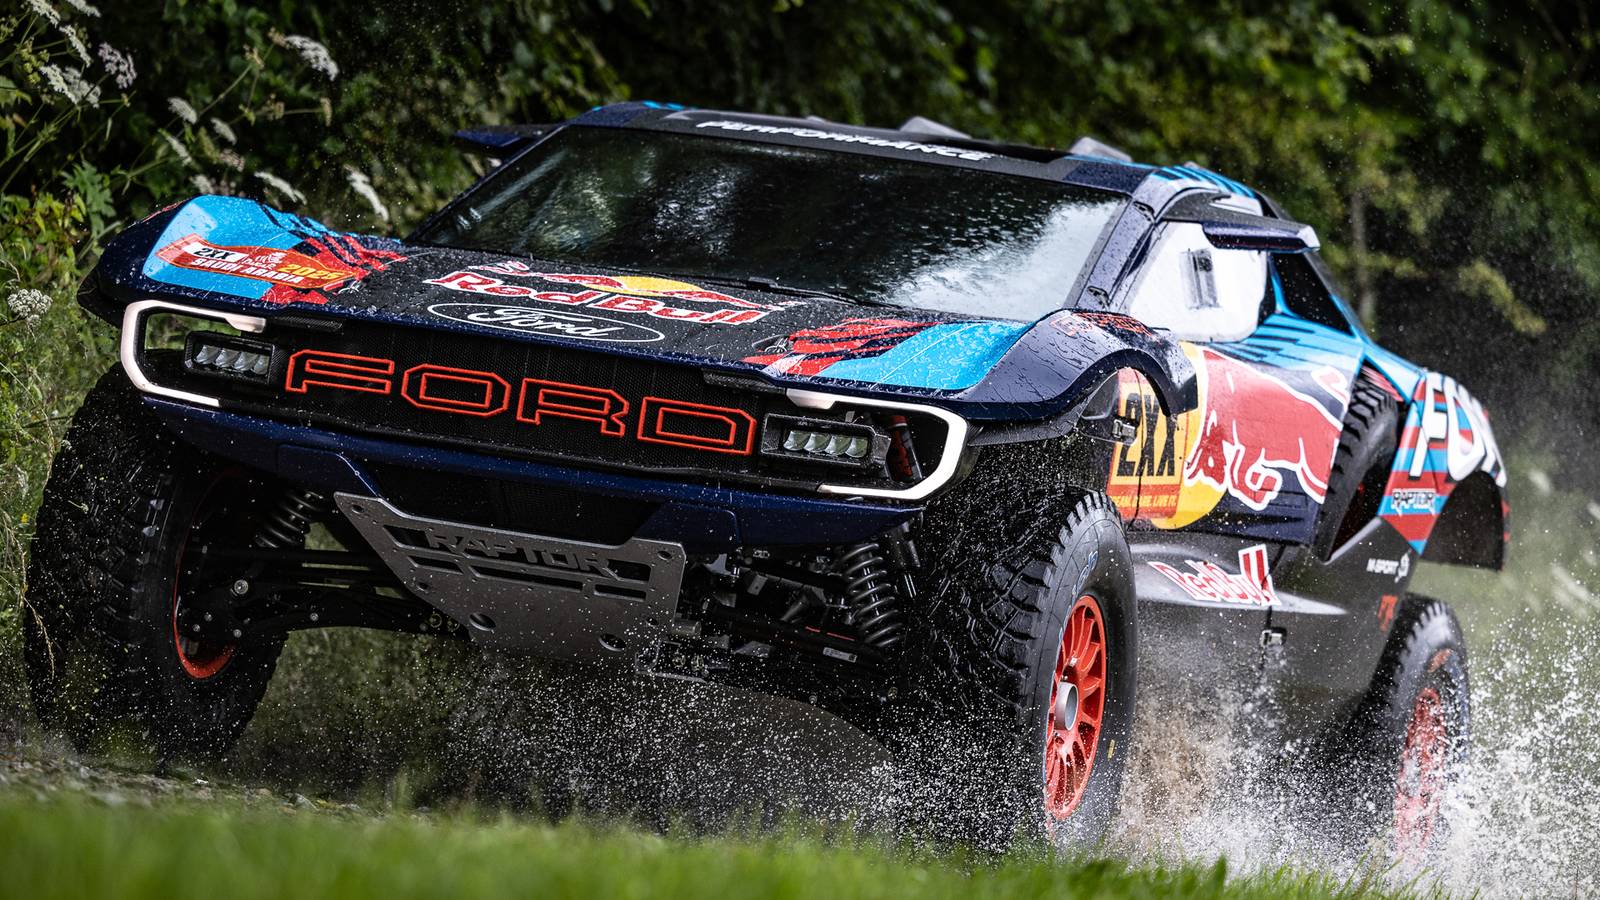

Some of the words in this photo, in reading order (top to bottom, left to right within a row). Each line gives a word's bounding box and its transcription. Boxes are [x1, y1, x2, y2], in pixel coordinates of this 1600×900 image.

[696, 120, 995, 162] PERFORMANCE
[191, 257, 244, 272] SAUDI
[240, 266, 304, 283] ARABIA
[194, 247, 235, 260] 2XX
[277, 263, 345, 280] 2025
[423, 271, 605, 306] Red
[588, 294, 769, 326] Bull
[467, 308, 625, 337] Ford
[285, 349, 758, 456] FORD
[1117, 392, 1176, 477] 2XX
[1391, 488, 1438, 516] RAPTOR
[424, 529, 623, 581] RAPTOR
[1147, 560, 1232, 602] Red
[1196, 543, 1282, 606] Bull
